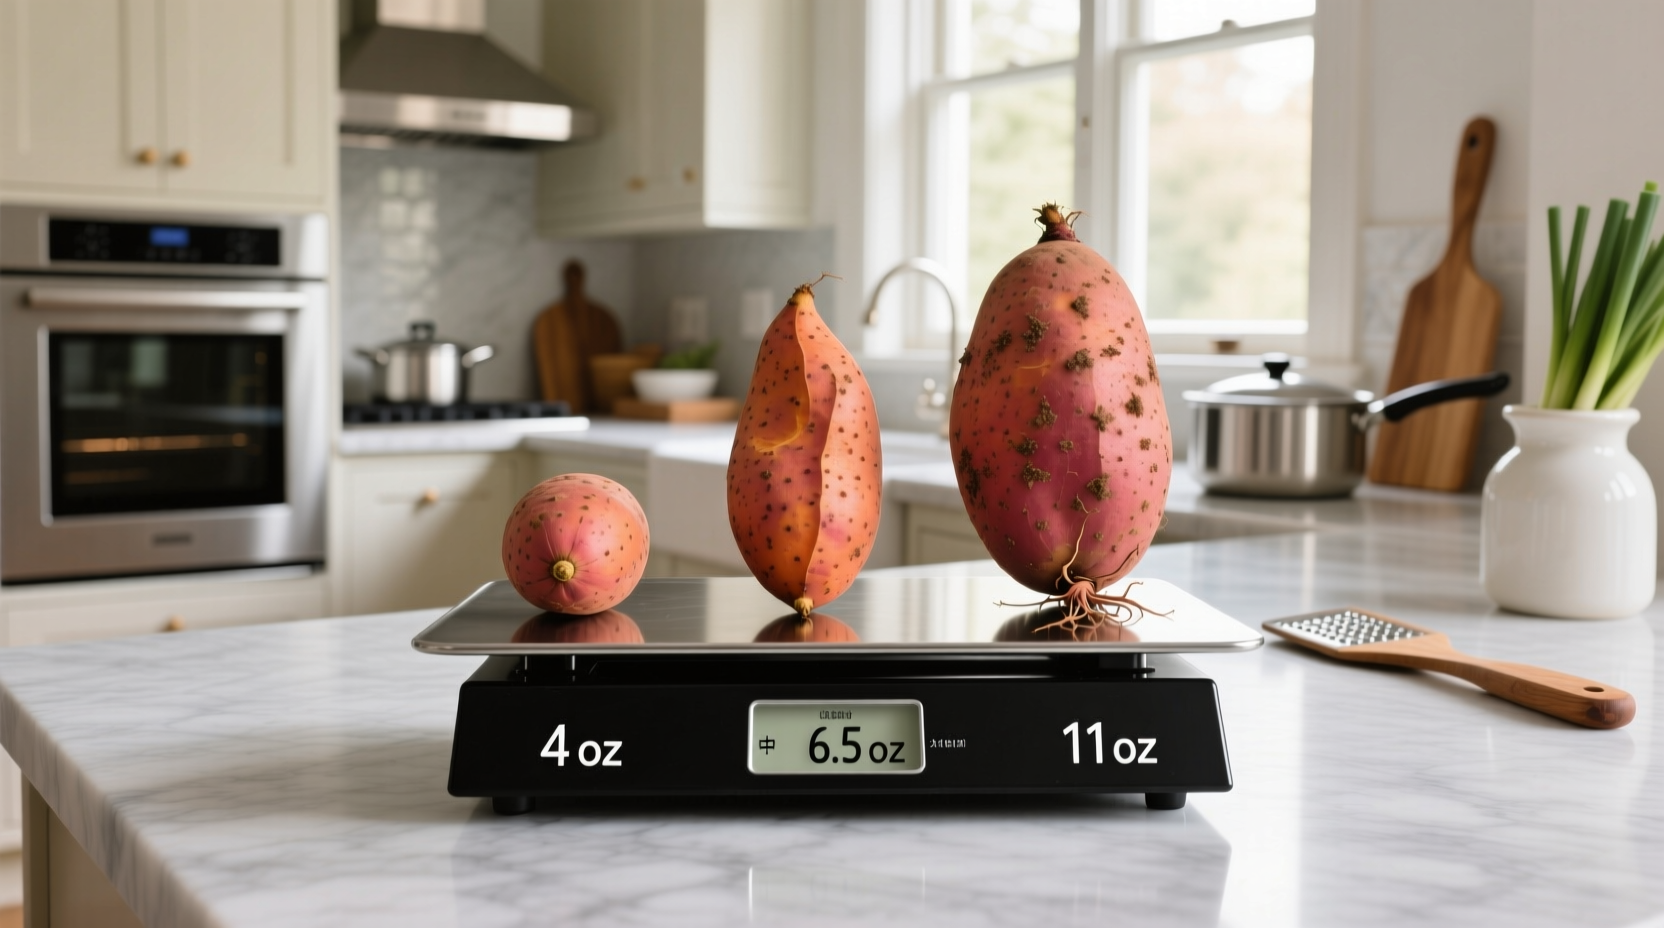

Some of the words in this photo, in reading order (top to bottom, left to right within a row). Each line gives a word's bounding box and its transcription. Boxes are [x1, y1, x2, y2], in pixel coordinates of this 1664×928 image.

[539, 723, 570, 767] 4
[578, 740, 623, 767] oz
[808, 726, 862, 764] 6.5
[868, 741, 906, 764] oz
[1061, 721, 1104, 764] 11
[1113, 737, 1158, 765] oz
